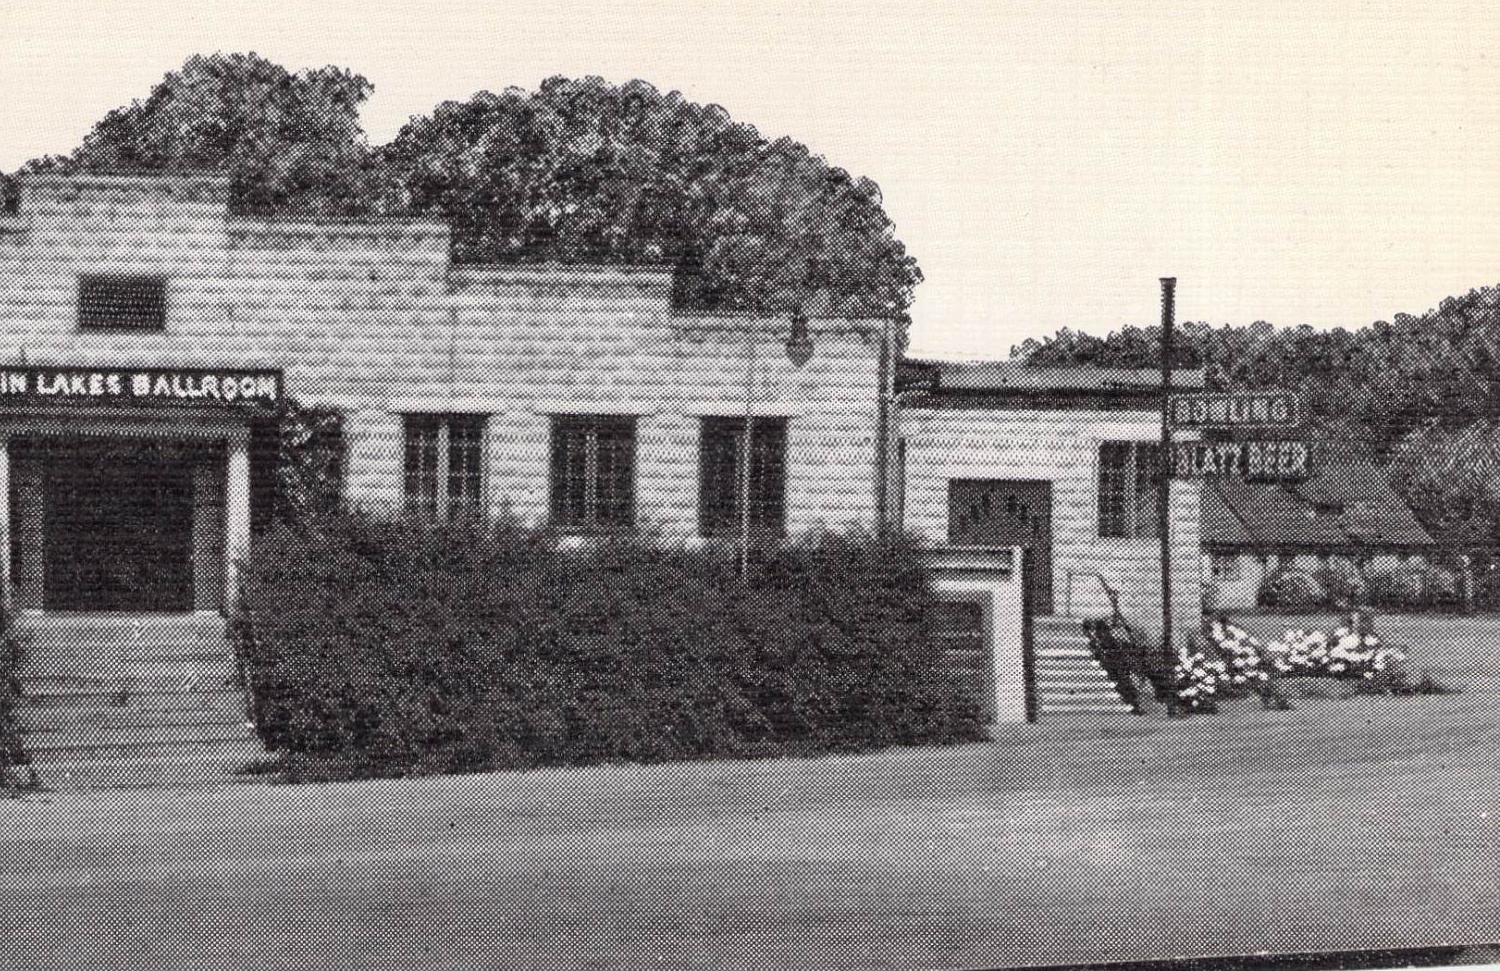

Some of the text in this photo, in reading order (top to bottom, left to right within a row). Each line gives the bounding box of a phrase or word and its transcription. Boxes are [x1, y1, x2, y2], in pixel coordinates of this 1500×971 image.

[37, 372, 121, 397] LAKES
[132, 373, 277, 401] BALLROOM
[1174, 398, 1288, 423] BOWLING
[1249, 440, 1307, 475] BEER
